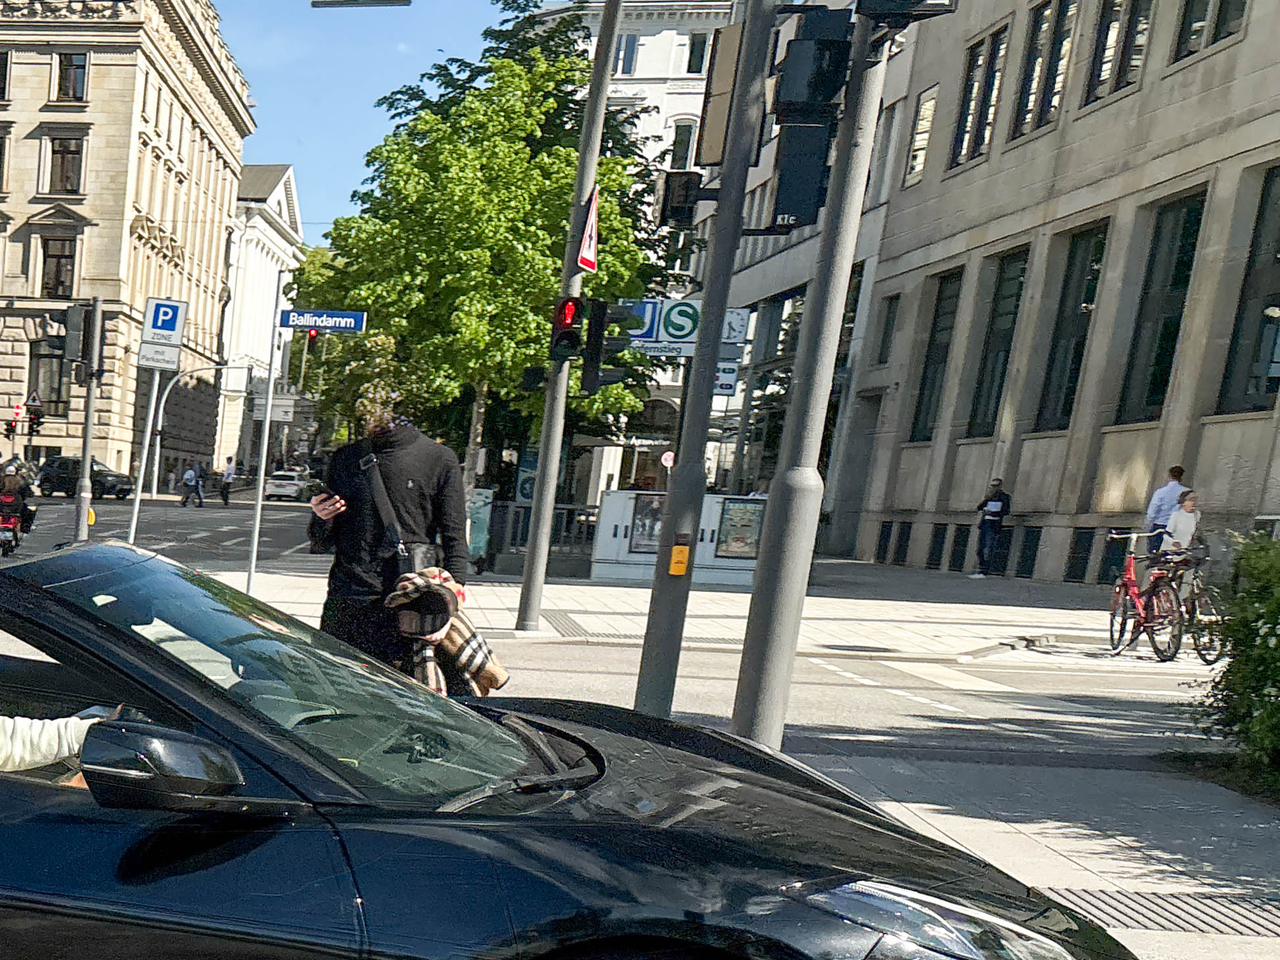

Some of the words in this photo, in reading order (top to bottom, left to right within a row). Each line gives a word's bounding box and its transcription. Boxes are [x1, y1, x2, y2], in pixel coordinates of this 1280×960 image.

[157, 307, 173, 327] P
[288, 312, 355, 328] Ballindamm
[668, 305, 694, 336] S
[151, 332, 173, 342] ZONE
